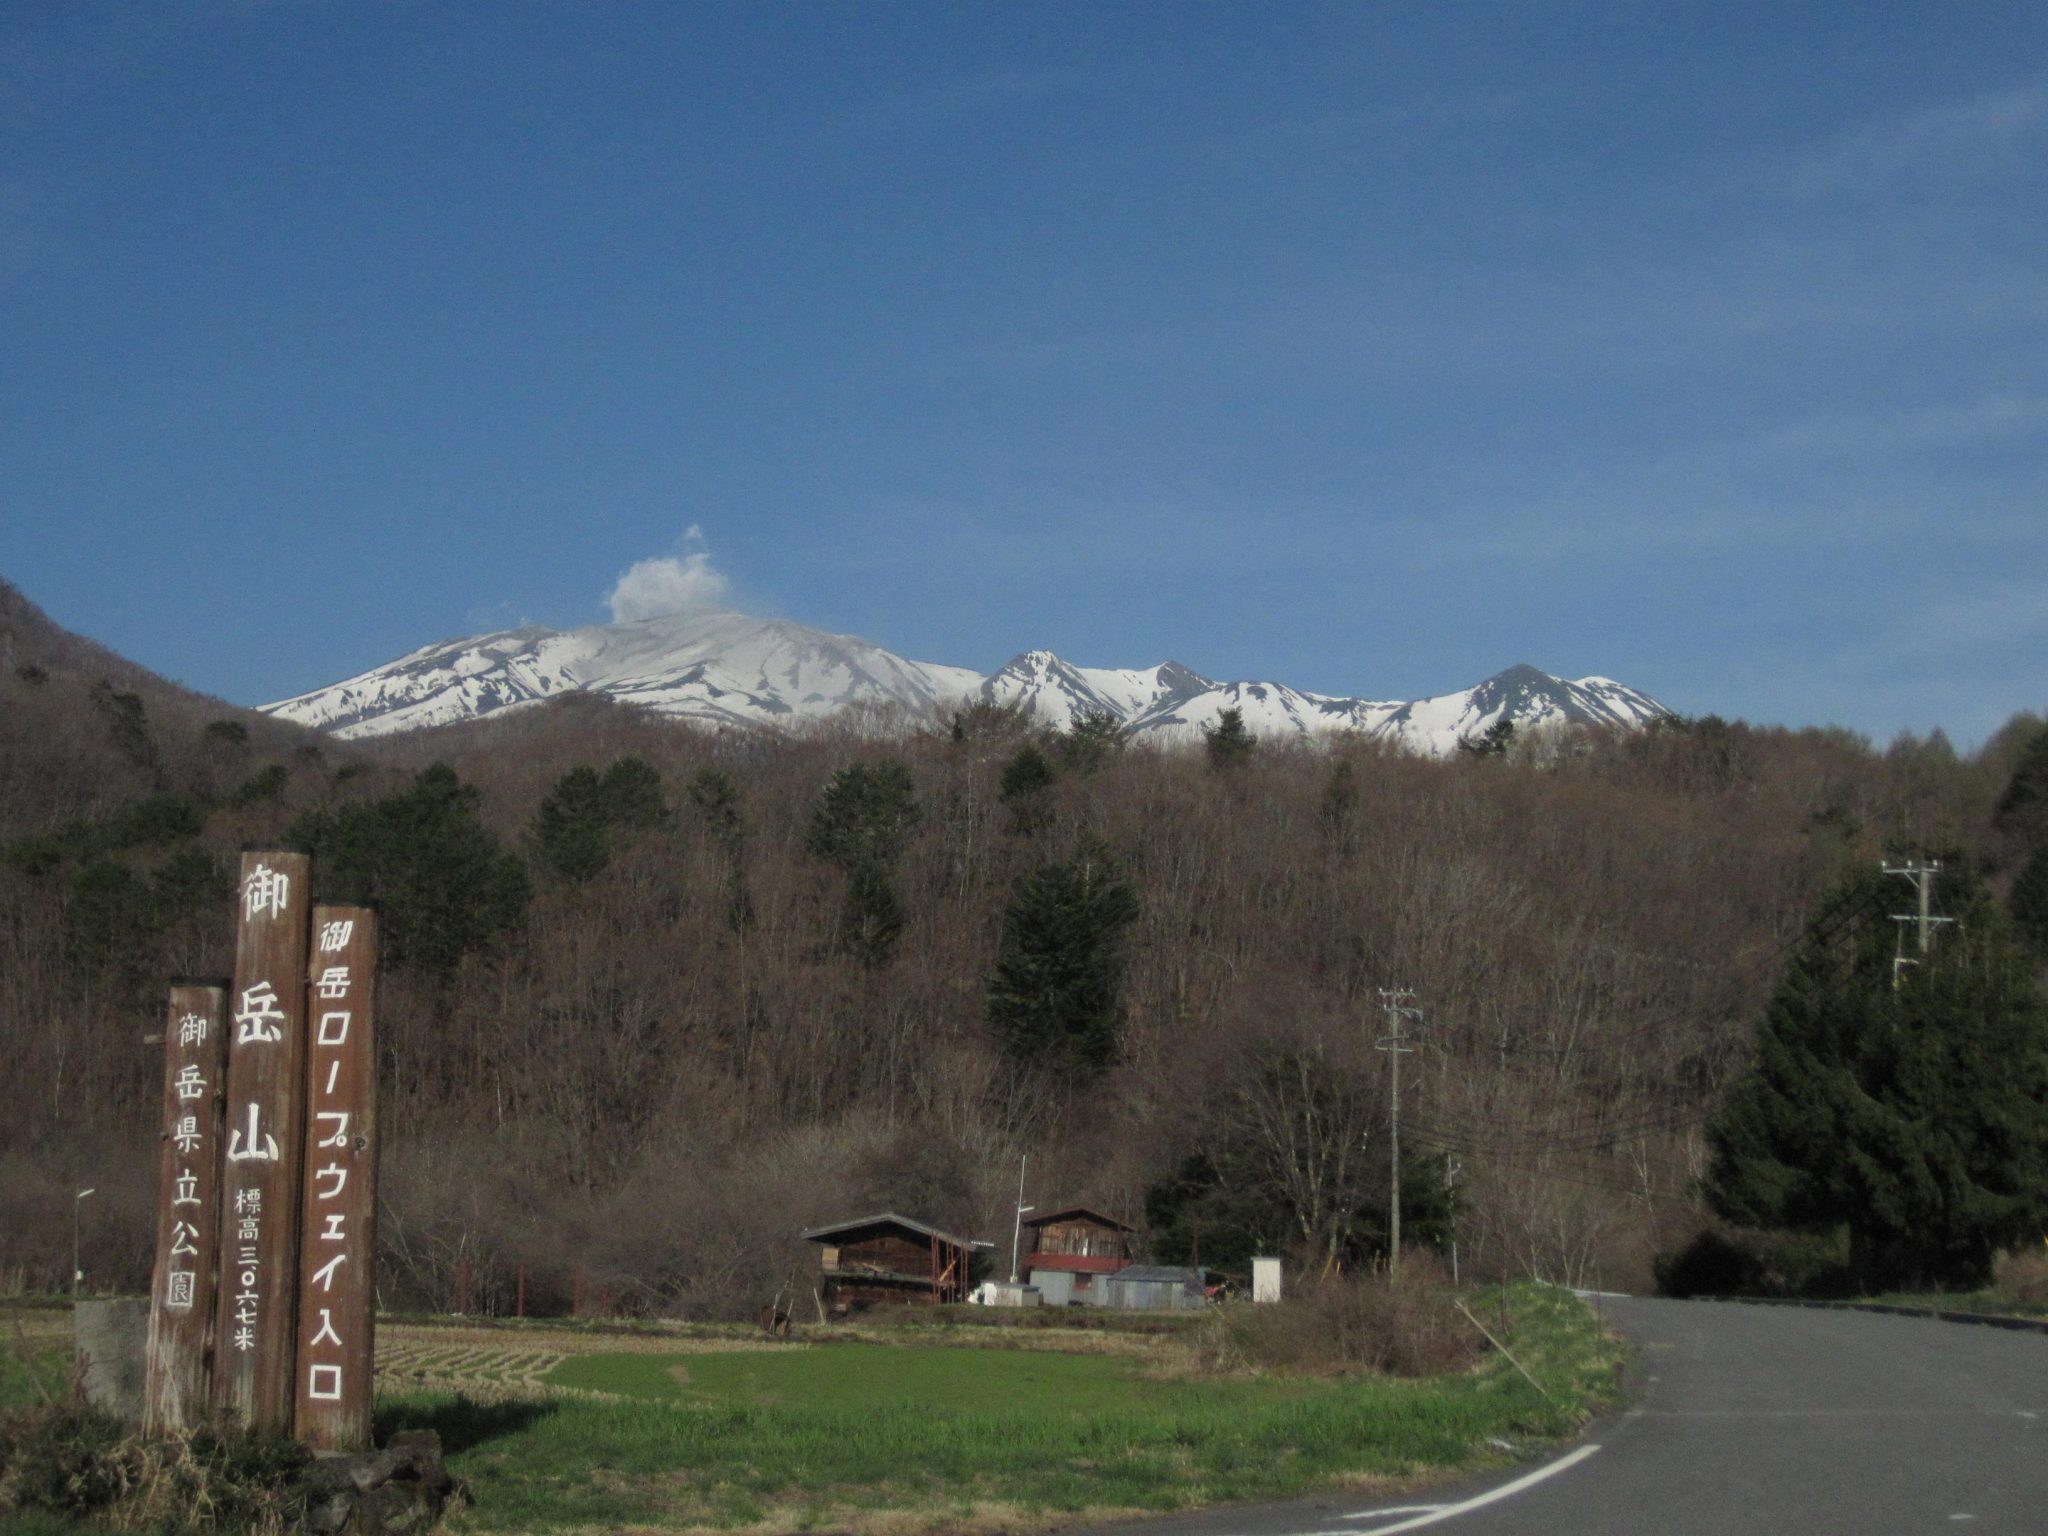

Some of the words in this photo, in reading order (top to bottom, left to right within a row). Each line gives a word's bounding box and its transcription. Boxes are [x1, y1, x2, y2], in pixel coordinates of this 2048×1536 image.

[167, 1012, 208, 1308] 御岳県立公園
[227, 863, 289, 1162] 御岳山
[309, 920, 354, 1400] 御岳ロープウェイ入口
